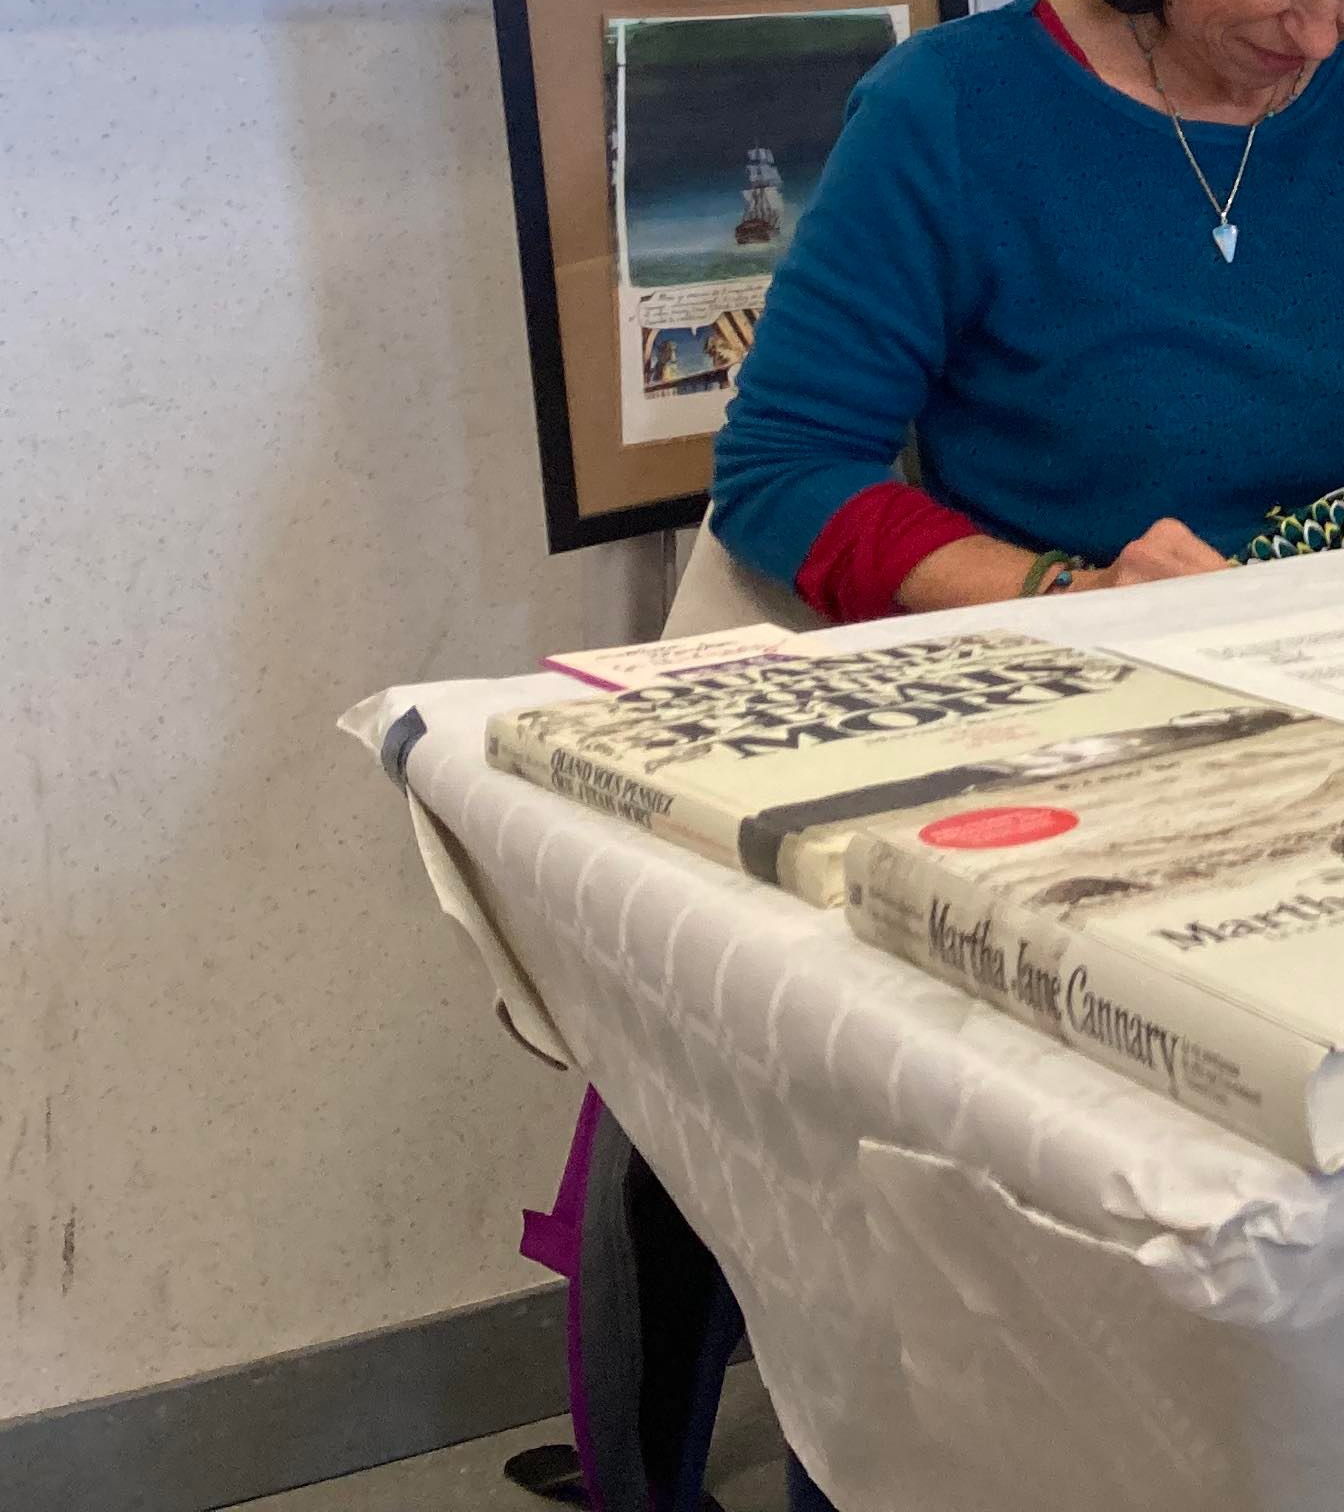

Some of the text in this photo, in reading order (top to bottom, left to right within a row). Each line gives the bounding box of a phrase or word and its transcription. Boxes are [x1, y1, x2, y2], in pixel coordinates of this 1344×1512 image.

[927, 893, 1009, 995] Martha
[1010, 934, 1064, 1022] Jane
[1064, 962, 1182, 1098] Cannary
